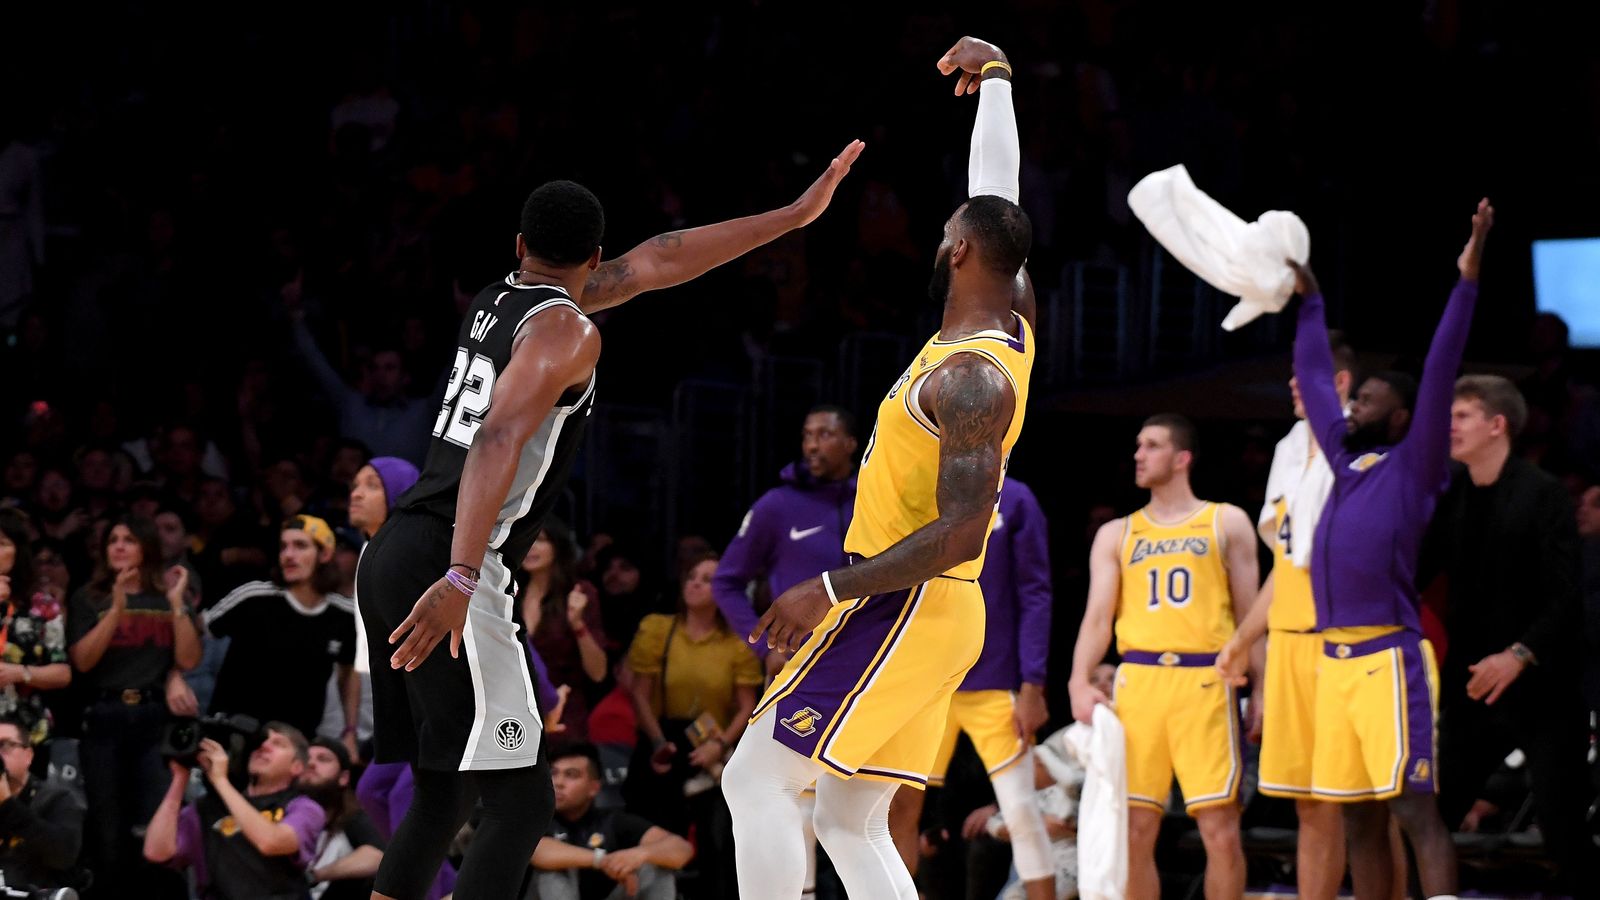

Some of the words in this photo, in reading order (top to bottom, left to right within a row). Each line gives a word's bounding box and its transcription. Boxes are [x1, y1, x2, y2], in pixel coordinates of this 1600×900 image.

[470, 310, 498, 342] GAY
[432, 346, 496, 449] 22
[1129, 537, 1208, 566] LAKERS
[1148, 566, 1191, 608] 10
